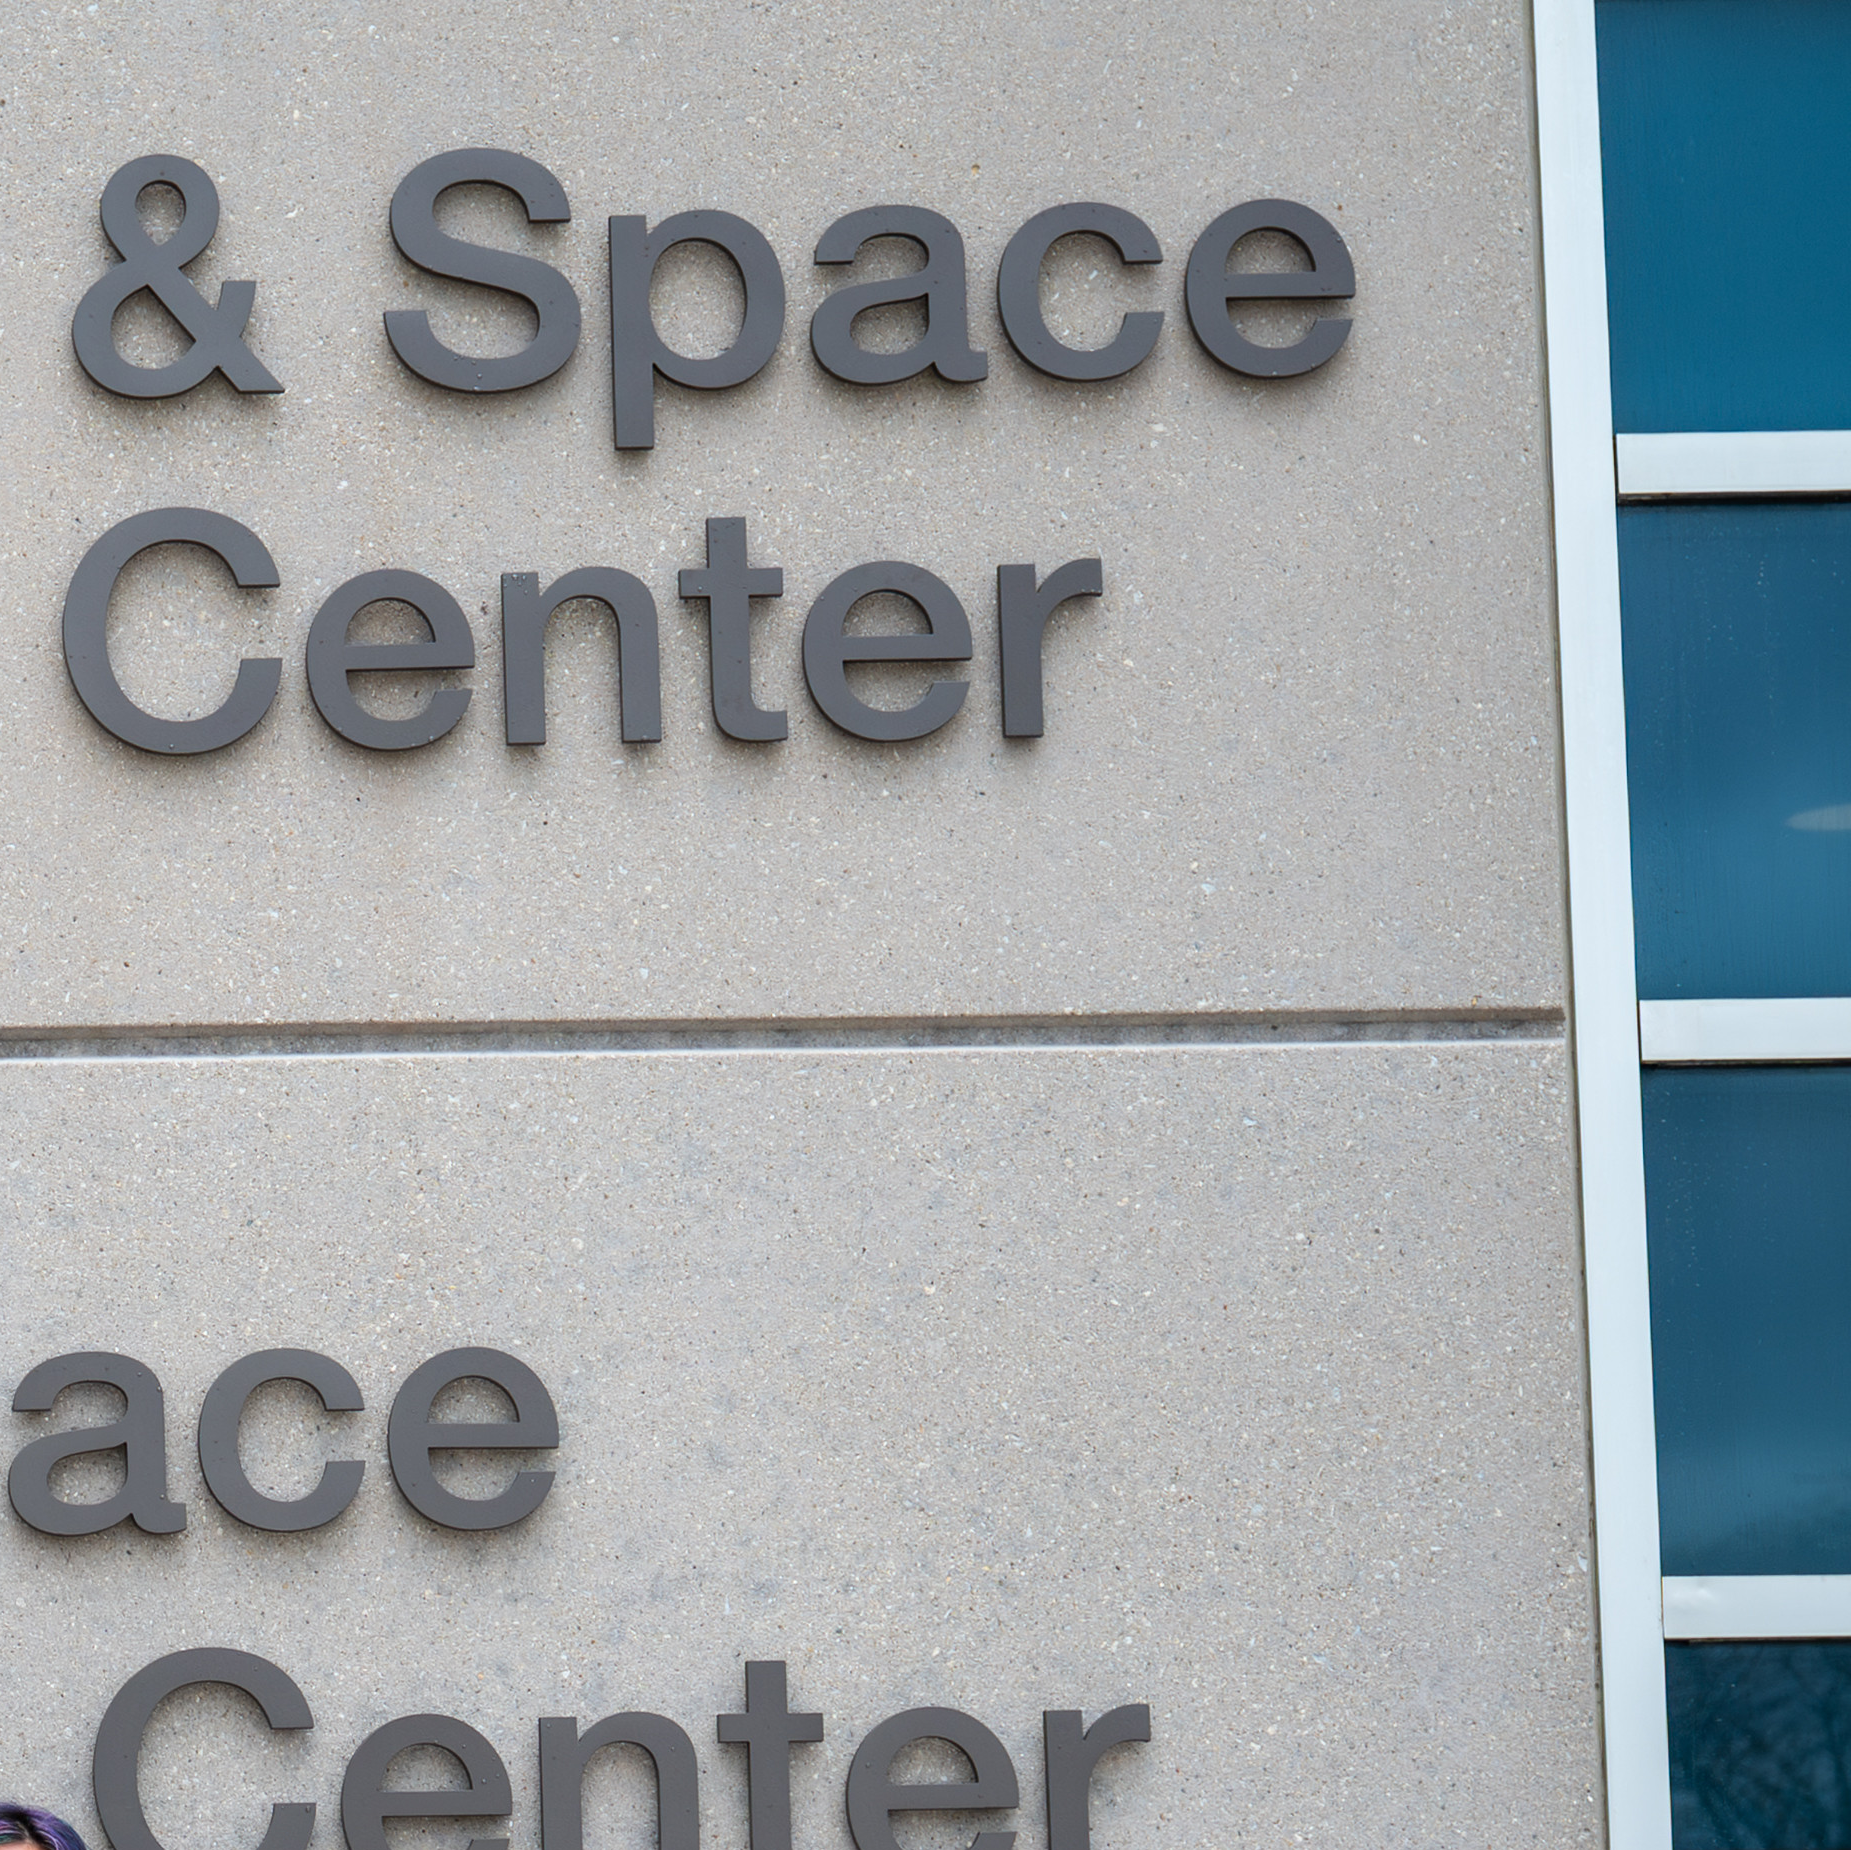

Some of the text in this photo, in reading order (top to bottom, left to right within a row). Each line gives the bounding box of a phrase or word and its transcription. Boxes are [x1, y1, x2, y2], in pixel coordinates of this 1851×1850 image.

[71, 153, 286, 400] &
[382, 147, 1357, 452] Space
[62, 506, 1104, 757] Center
